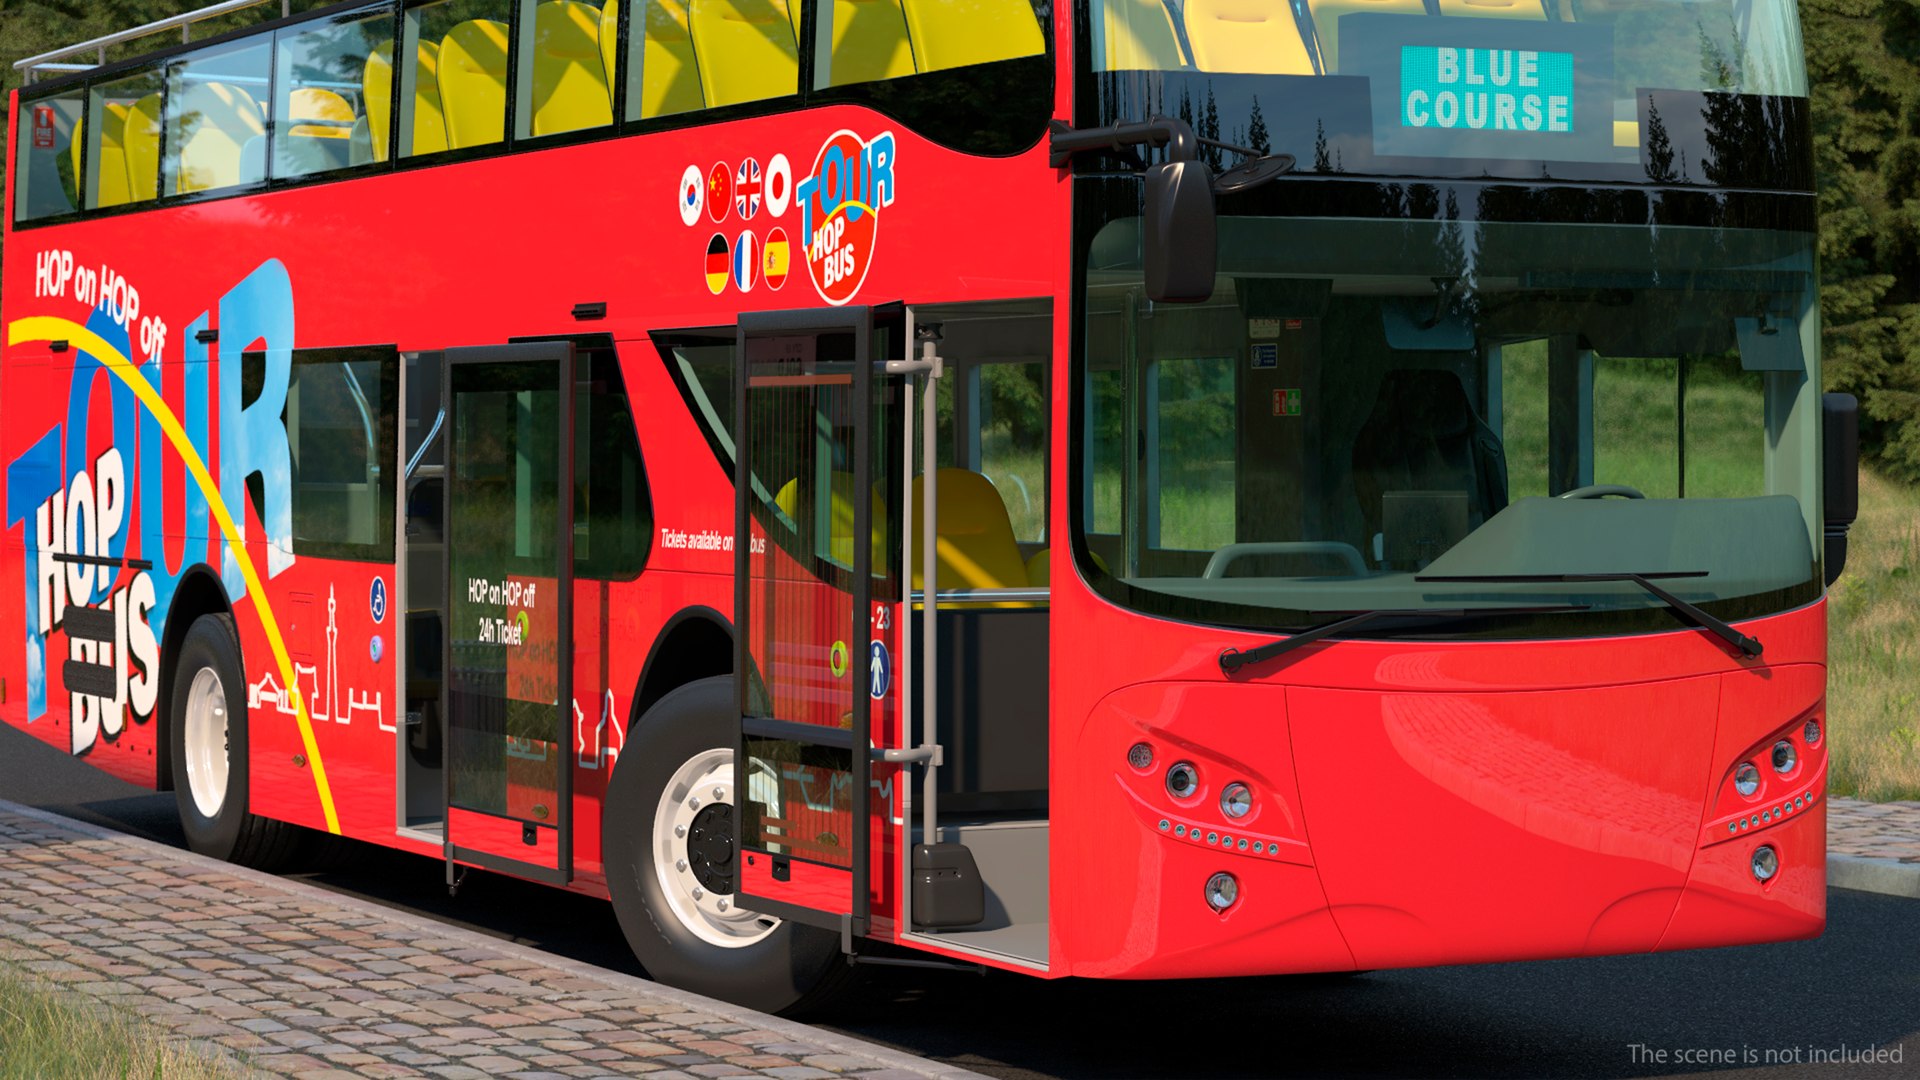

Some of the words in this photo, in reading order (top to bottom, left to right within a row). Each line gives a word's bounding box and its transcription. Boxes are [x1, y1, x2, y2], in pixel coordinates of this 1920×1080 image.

[1438, 47, 1539, 87] BLUE
[1407, 90, 1569, 132] COURSE
[797, 131, 895, 250] TOUR
[812, 216, 845, 262] HOP
[823, 243, 855, 289] BUS
[35, 249, 74, 298] HOP
[74, 265, 97, 307] on
[99, 264, 140, 333] HOP
[140, 315, 167, 370] off
[7, 258, 296, 724] TOUR
[36, 447, 125, 637] HOP
[661, 528, 687, 549] Tickets
[687, 530, 722, 551] available
[722, 535, 734, 551] on
[750, 533, 766, 554] bus
[468, 577, 488, 603] HOP
[489, 584, 500, 605] on
[501, 581, 522, 607] HOP
[523, 583, 536, 608] off
[479, 617, 495, 643] 24h
[496, 619, 522, 646] Ticket
[876, 605, 890, 630] 23
